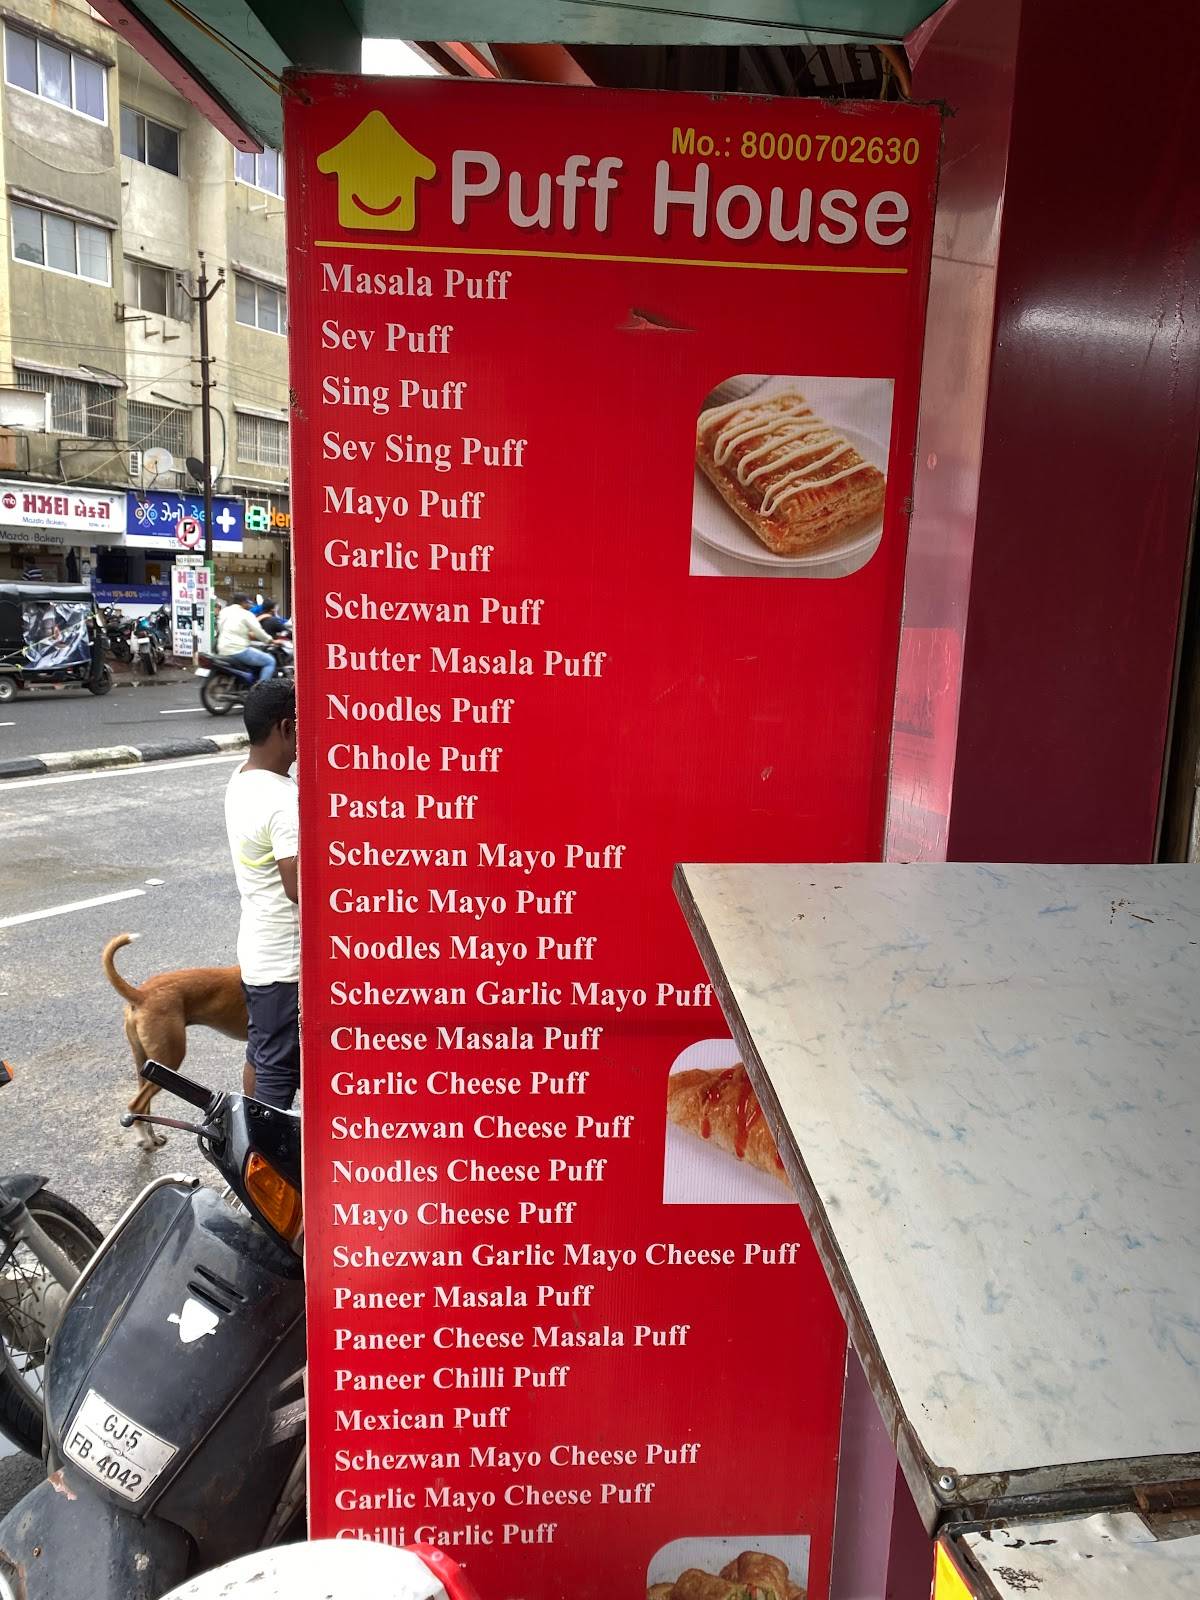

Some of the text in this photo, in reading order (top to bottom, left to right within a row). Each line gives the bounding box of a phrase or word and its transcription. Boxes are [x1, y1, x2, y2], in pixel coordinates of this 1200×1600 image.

[672, 126, 920, 166] Mo.: 8000702630
[451, 149, 910, 246] Puff House
[321, 263, 512, 299] Masala Puff
[322, 320, 453, 353] Sev Puff
[323, 376, 467, 415] Sing Puff
[323, 431, 527, 472] Sev Sing Puff
[323, 486, 485, 523] Mayo Puff
[34, 533, 64, 544] Bakery
[325, 540, 494, 572] Garlic Puff
[326, 592, 544, 625] Schezwan Puff
[326, 644, 606, 677] Butter Masala Puff
[326, 694, 515, 723] Noodles Puff
[328, 744, 503, 772] Chhole Puff
[328, 793, 478, 819] Pasta Puff
[329, 841, 626, 874] Schezwan Mayo Puff
[330, 889, 576, 920] Garlic Mayo Puff
[329, 936, 597, 966] Noodles Mayo Puff
[331, 981, 713, 1012] Schezwan Garlic Mayo Puff
[331, 1027, 603, 1050] Cheese Masala Puff
[331, 1071, 589, 1095] Garlic Cheese Puff
[332, 1116, 634, 1139] Schezwan Cheese Puff
[331, 1159, 607, 1183] Noodles Cheese Puff
[331, 1202, 577, 1231] Mayo Cheese Puff
[333, 1243, 800, 1271] Schezwan Garlic Mayo Cheese Puff
[333, 1285, 594, 1309] Paneer Masala Puff
[335, 1325, 690, 1350] Paneer Cheese Masala Puff
[335, 1366, 570, 1390] Paneer Chilli Puff
[335, 1407, 510, 1431] Mexican Puff
[336, 1443, 701, 1472] Schezwan Mayo Cheese Puff
[335, 1483, 655, 1512] Garlic Mayo Cheese Puff
[414, 1525, 494, 1546] Garlic
[502, 1523, 557, 1545] Puff
